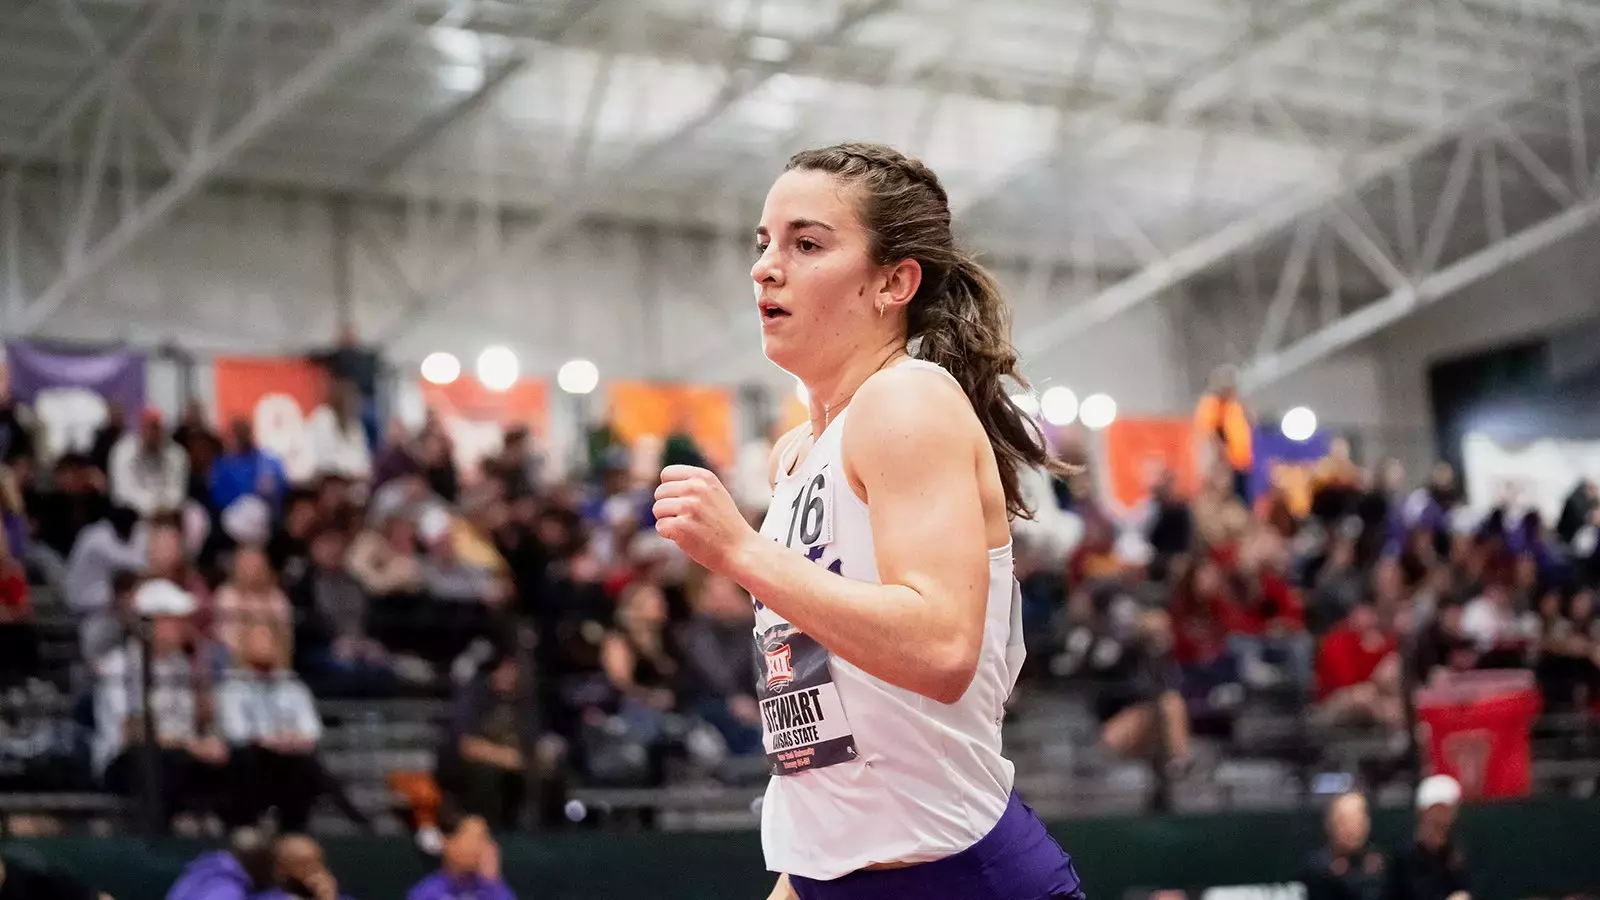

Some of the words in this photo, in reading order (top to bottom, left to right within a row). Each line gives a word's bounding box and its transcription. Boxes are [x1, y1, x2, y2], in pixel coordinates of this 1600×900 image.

[786, 473, 825, 548] 16
[762, 688, 824, 733] STEWART
[792, 725, 819, 745] STATE
